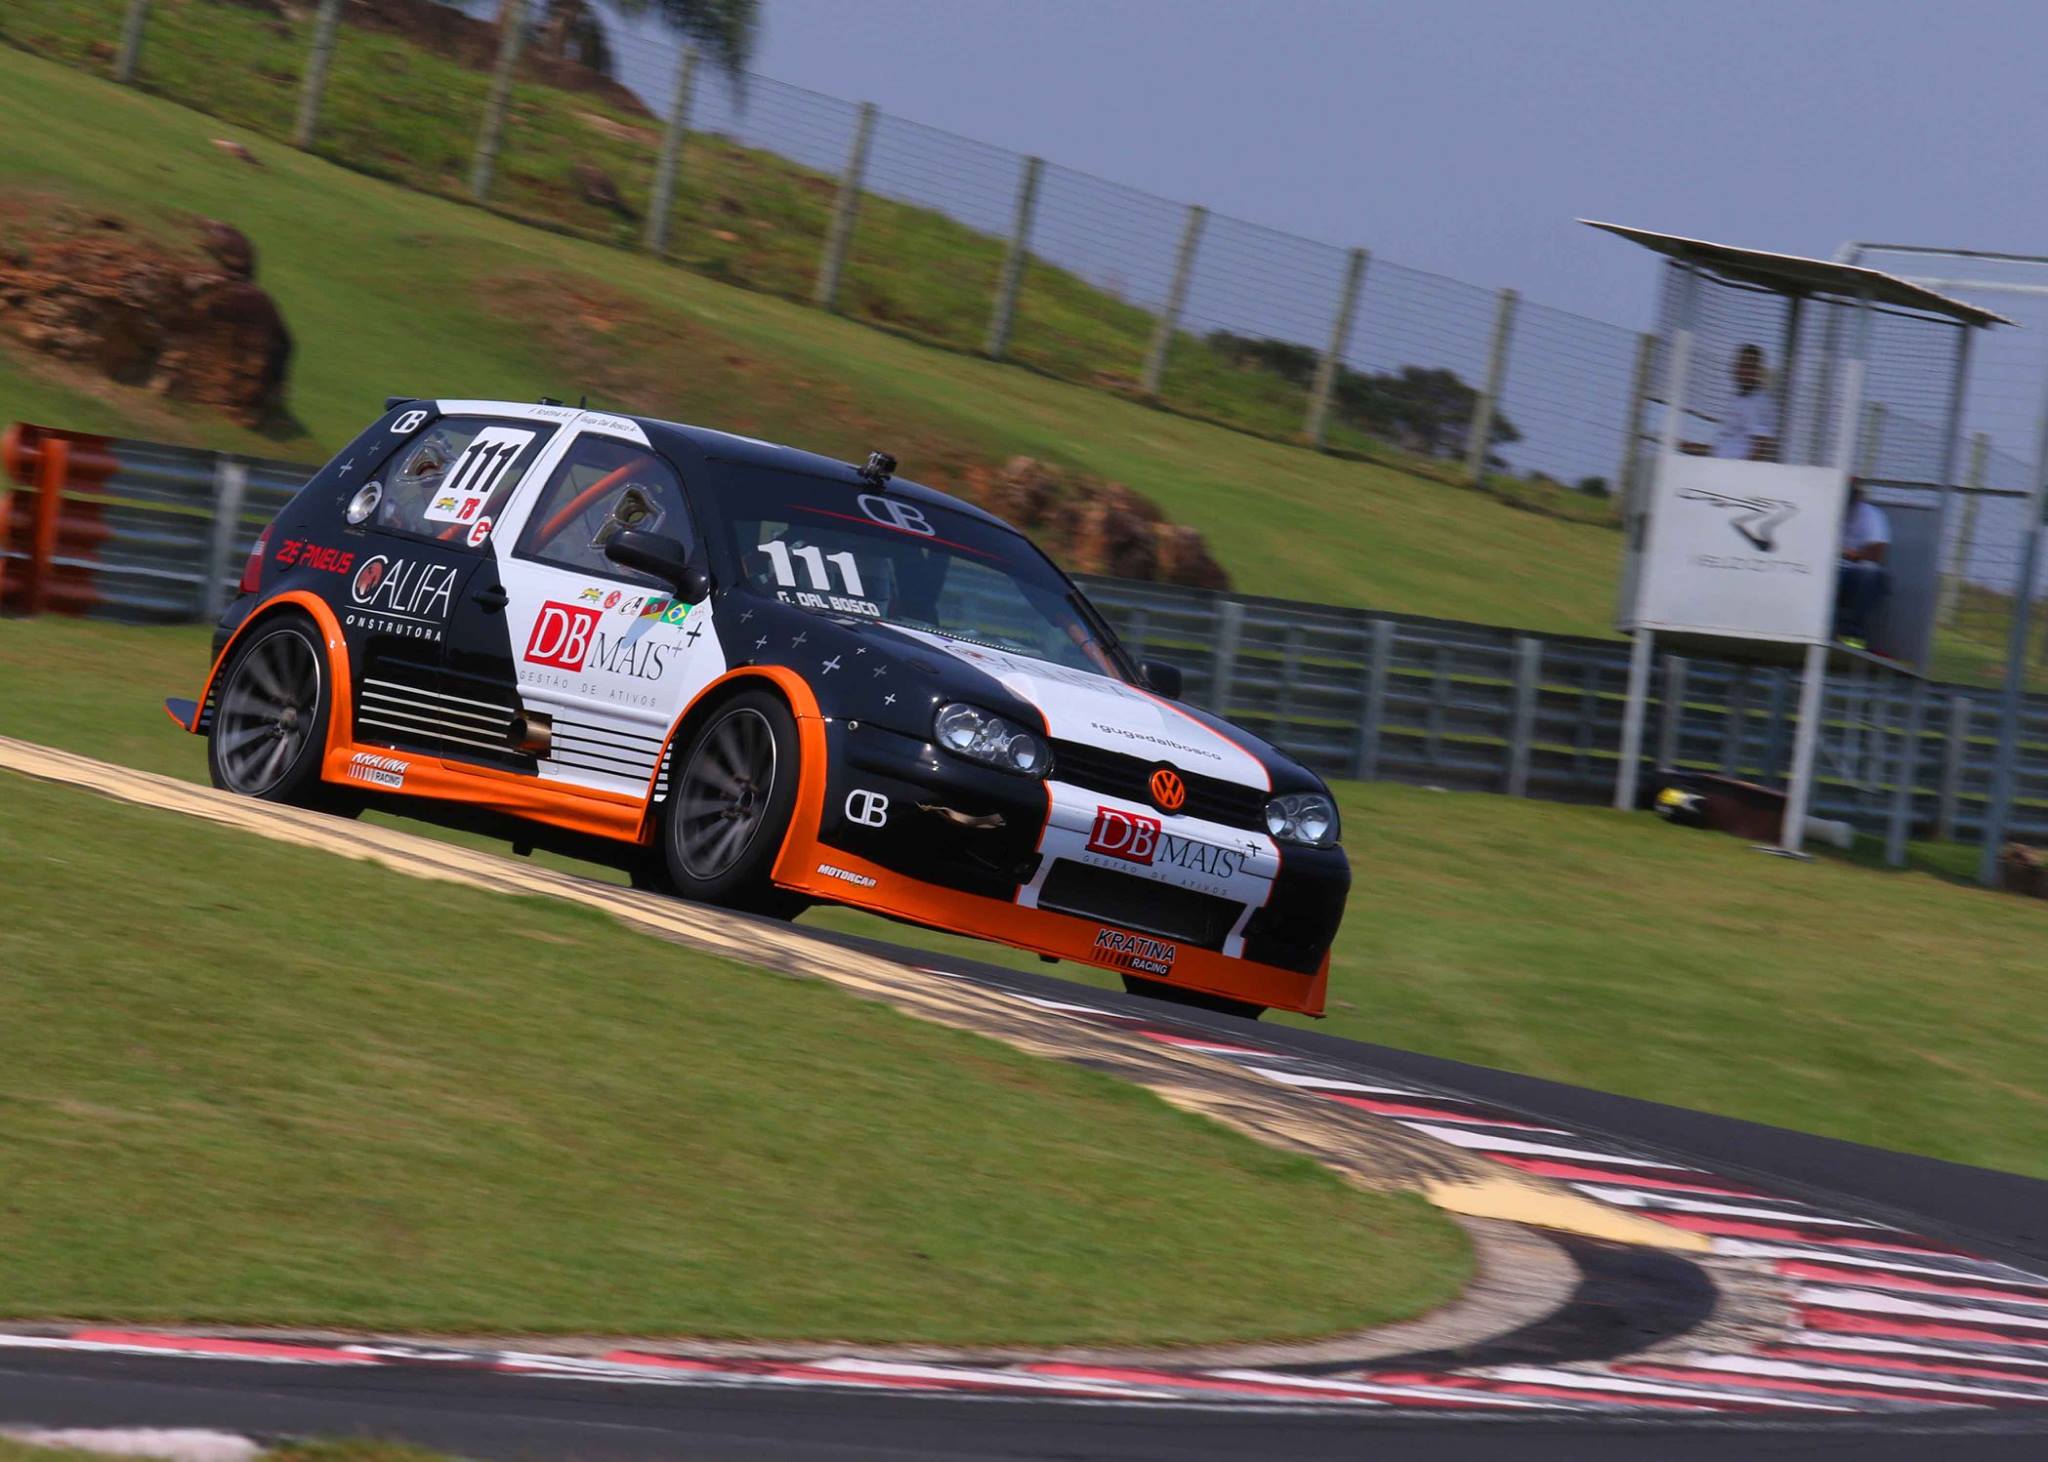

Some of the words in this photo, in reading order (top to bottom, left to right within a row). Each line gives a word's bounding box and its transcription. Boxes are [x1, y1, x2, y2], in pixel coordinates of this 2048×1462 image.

[449, 439, 522, 493] 111
[352, 554, 458, 618] CALIFA
[757, 540, 865, 597] 111
[796, 592, 829, 609] DAL
[828, 596, 881, 617] BOSCO
[528, 607, 592, 664] DB
[581, 683, 597, 695] DE
[609, 689, 657, 707] ATIVOS
[1094, 811, 1156, 857] DB
[817, 864, 877, 887] MOTORCAR
[1151, 871, 1168, 881] DE
[1181, 879, 1228, 897] ATIVOS
[1095, 928, 1176, 964] KRATINA
[1131, 958, 1168, 974] RACING
